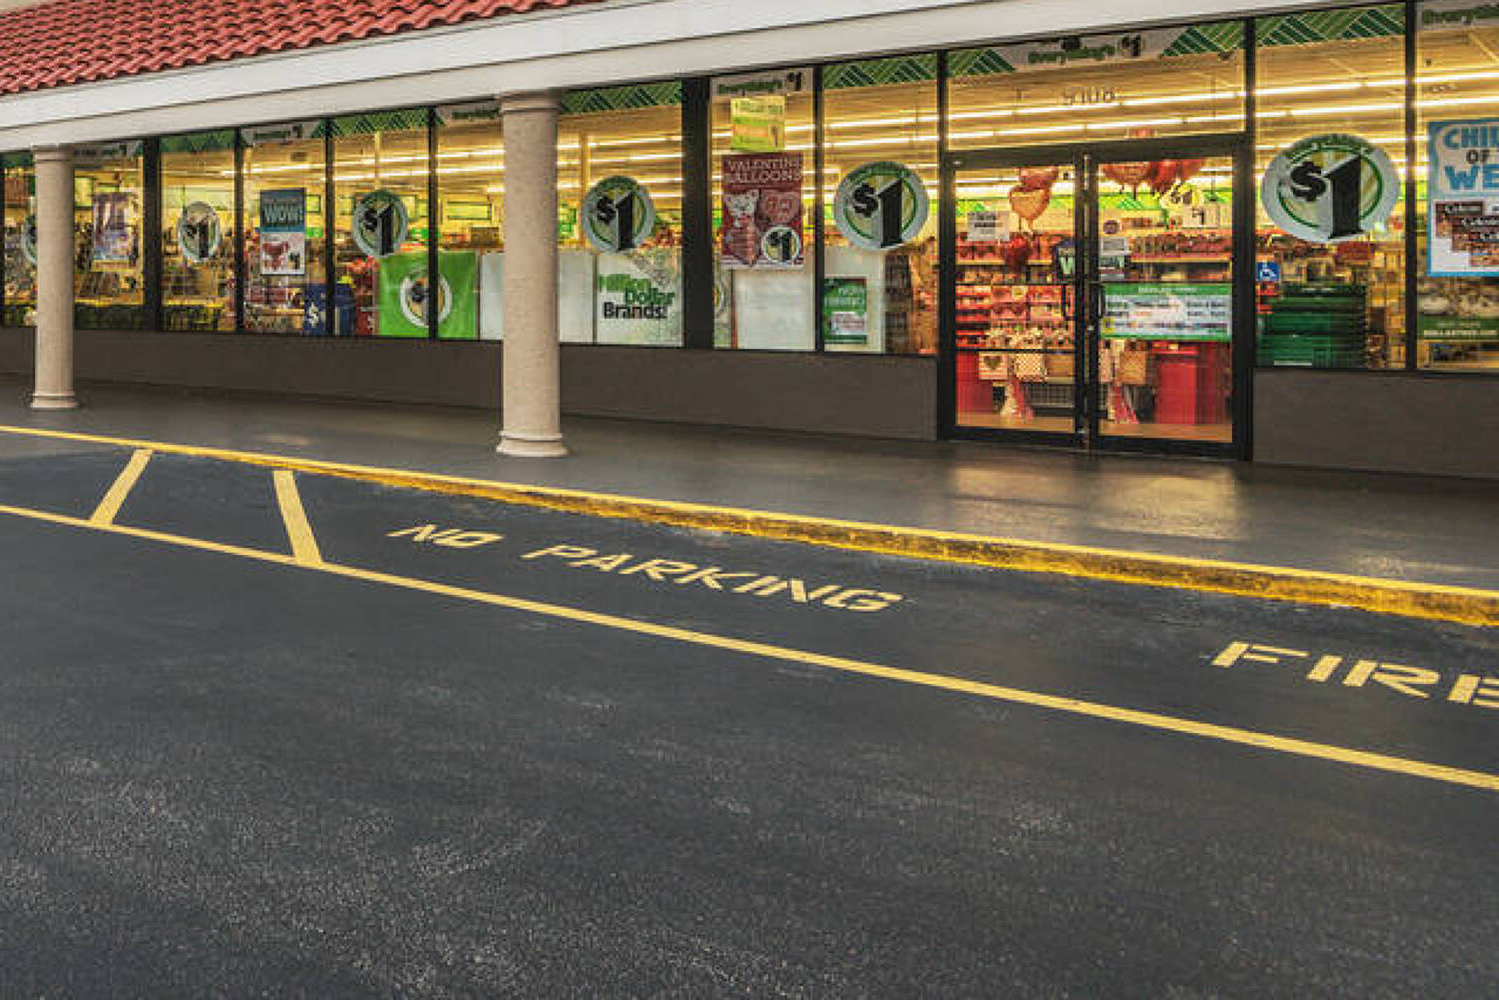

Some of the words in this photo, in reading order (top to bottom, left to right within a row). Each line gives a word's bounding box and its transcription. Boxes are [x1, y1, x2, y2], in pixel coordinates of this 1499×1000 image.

[1466, 149, 1490, 164] OF
[363, 203, 394, 256] $1
[596, 191, 635, 252] $1
[853, 178, 903, 249] $1
[1290, 155, 1365, 240] $1
[387, 523, 505, 549] NO
[521, 545, 903, 612] PARKING
[1210, 641, 1499, 708] FIRE
